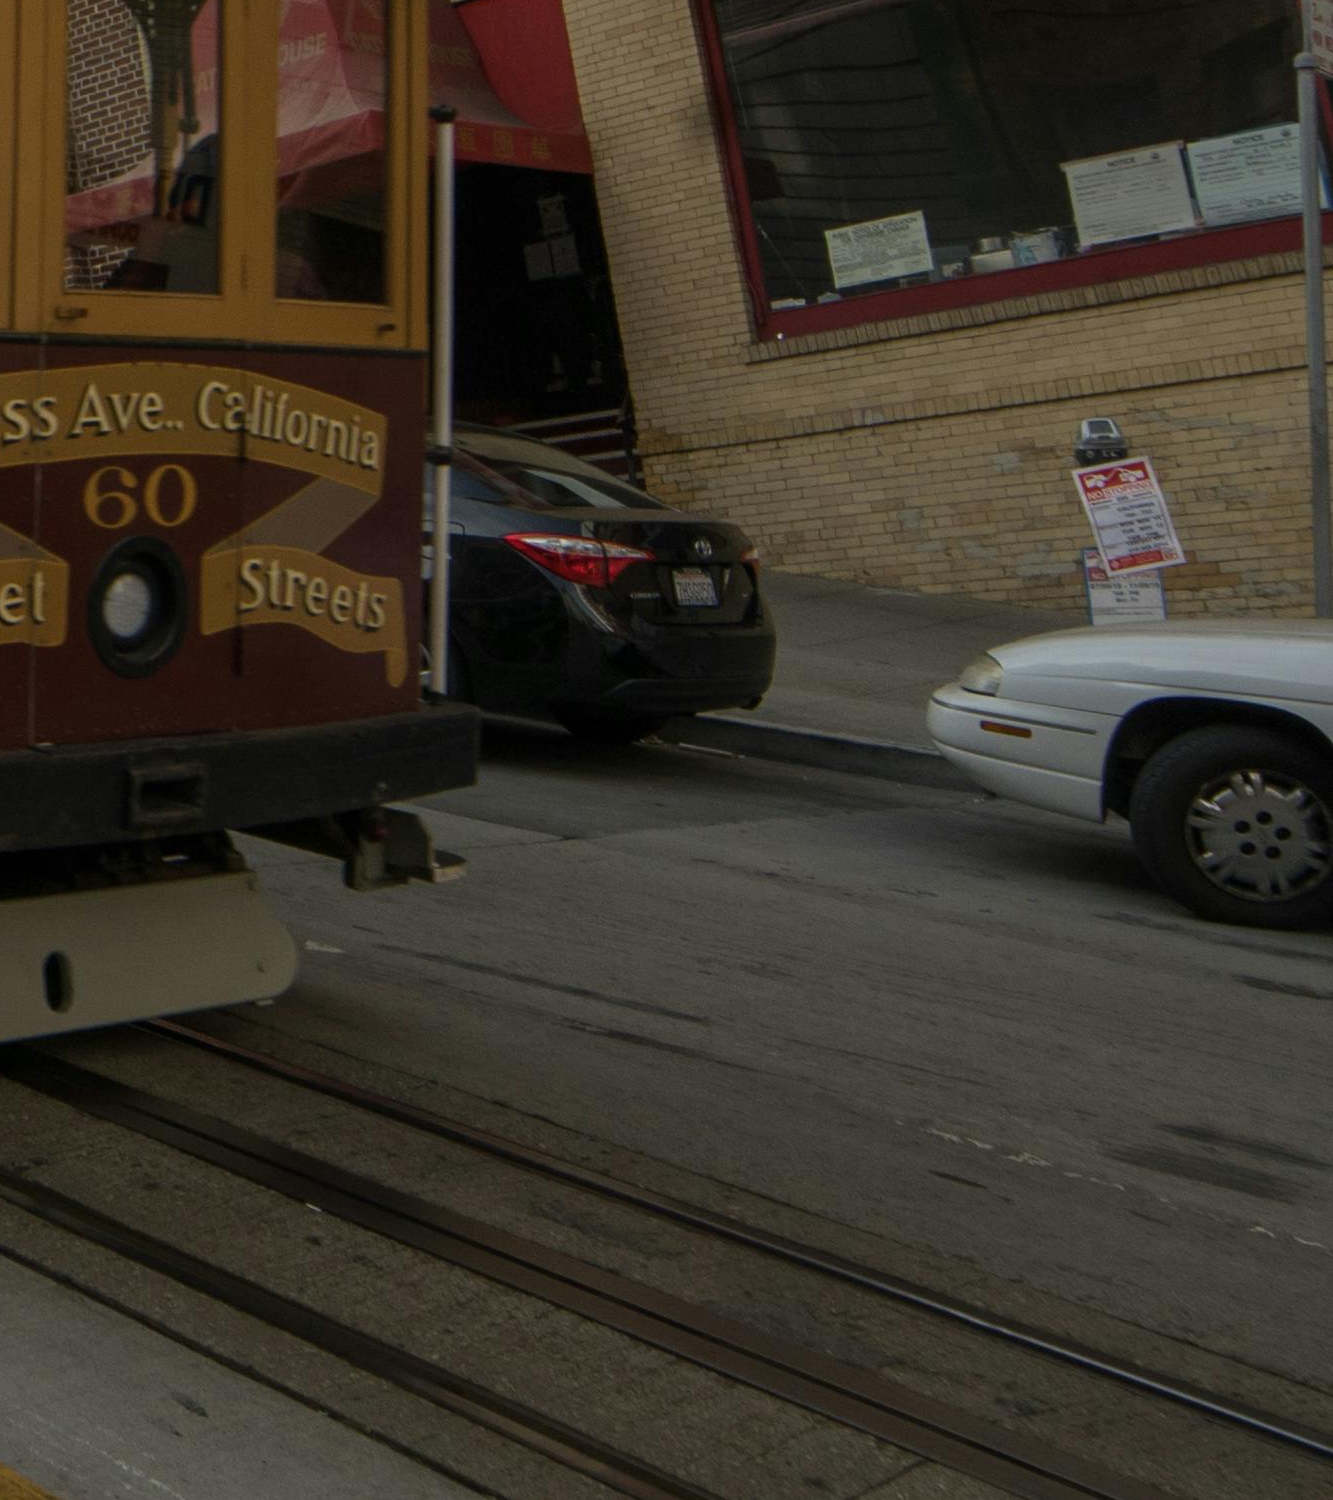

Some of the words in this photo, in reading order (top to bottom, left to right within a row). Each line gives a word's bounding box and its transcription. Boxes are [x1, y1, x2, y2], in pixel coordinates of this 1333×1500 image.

[198, 379, 381, 471] California
[83, 464, 198, 530] 60
[1087, 489, 1103, 501] NO
[236, 557, 388, 632] Streets
